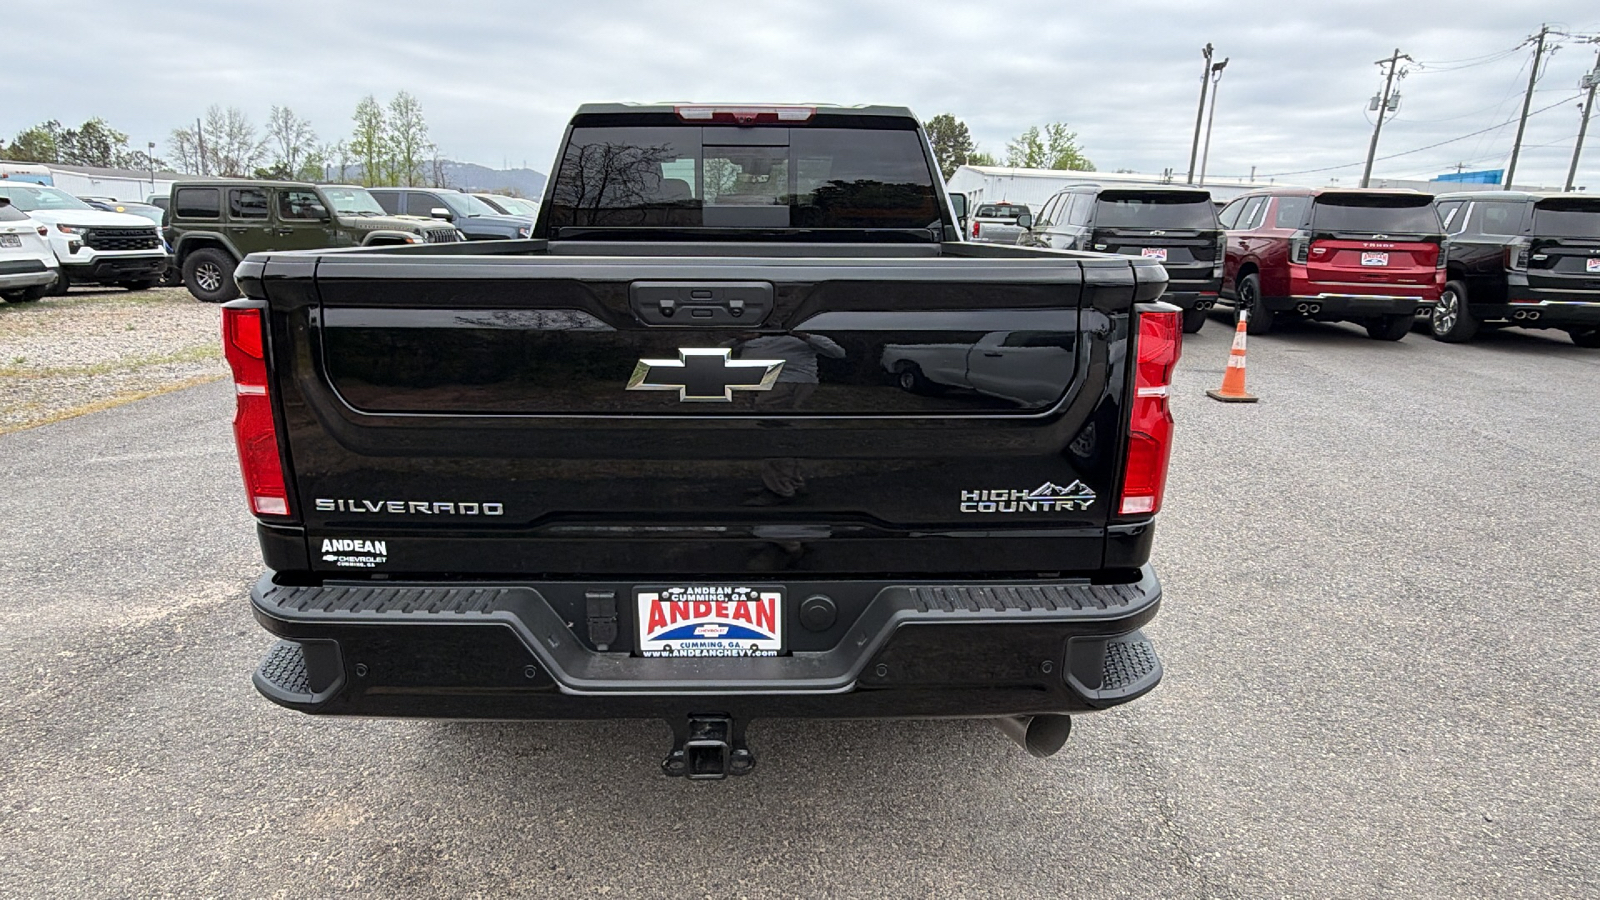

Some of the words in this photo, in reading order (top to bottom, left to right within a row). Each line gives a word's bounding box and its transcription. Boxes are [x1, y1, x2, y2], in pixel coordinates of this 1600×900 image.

[961, 490, 1029, 500] HIGH
[315, 498, 504, 515] SILVERADO
[960, 500, 1095, 512] COUNTRY
[321, 538, 387, 556] ANDEAN
[686, 587, 732, 595] ANDEAN
[671, 594, 729, 602] CUMMING,
[647, 598, 776, 636] ANDEAN
[679, 641, 726, 649] CUMMING,
[642, 649, 778, 658] www.ANDEANCHEVY.com
